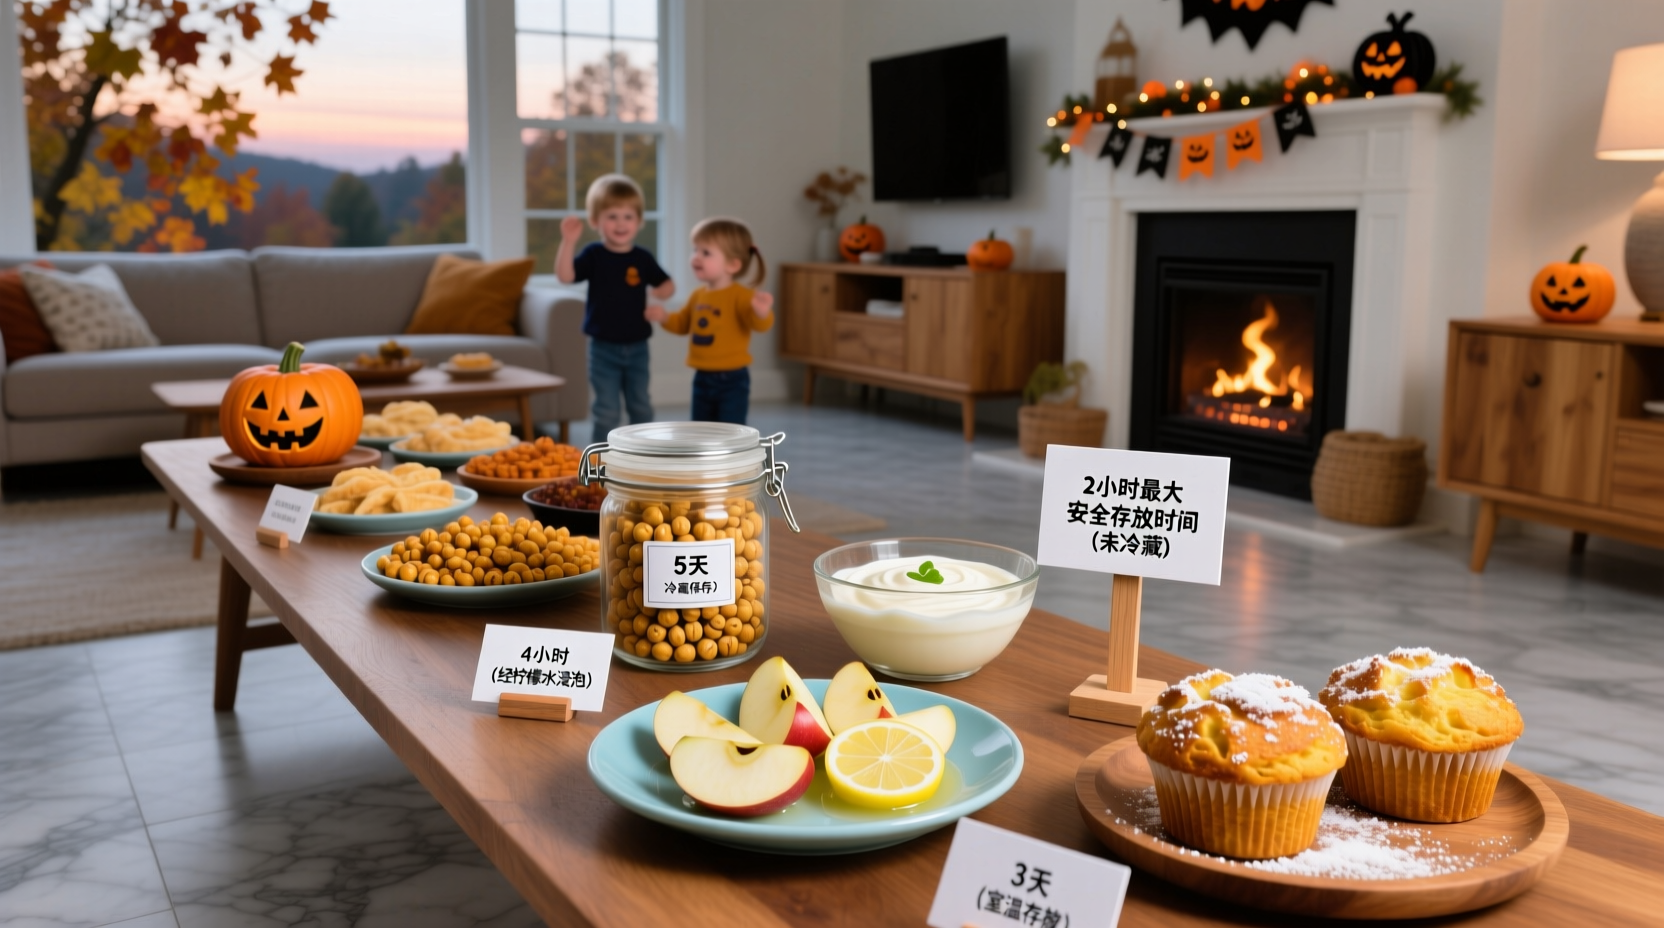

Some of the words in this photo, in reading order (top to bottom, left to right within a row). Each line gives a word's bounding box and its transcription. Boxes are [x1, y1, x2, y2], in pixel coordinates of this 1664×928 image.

[1083, 475, 1184, 504] 2小时最大
[1067, 500, 1199, 533] 安全存放时间
[1092, 531, 1170, 559] (未冷藏)
[673, 555, 709, 576] 5天
[520, 645, 570, 665] 4小时
[1010, 862, 1053, 898] 3天
